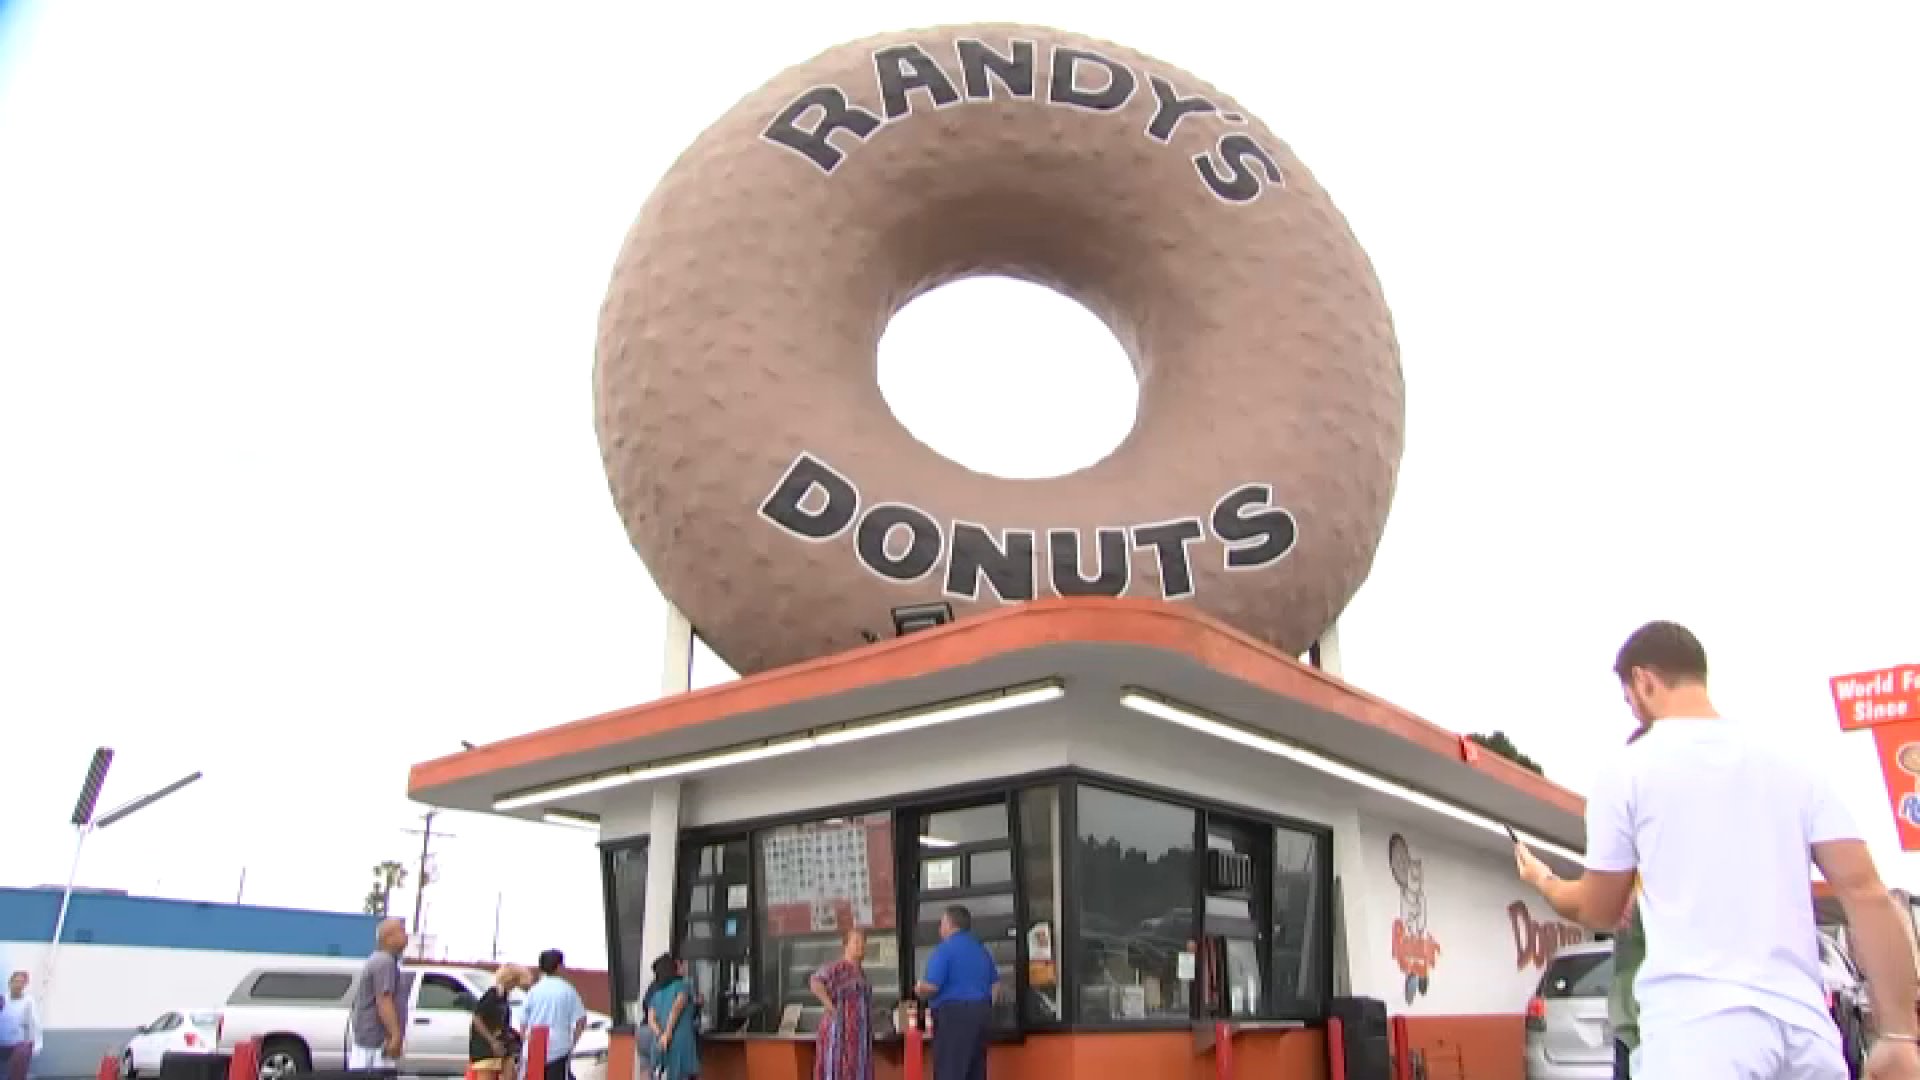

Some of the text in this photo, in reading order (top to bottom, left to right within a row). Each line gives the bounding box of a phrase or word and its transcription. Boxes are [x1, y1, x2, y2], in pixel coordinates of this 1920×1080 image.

[760, 38, 1285, 205] RANDY'S
[757, 451, 1297, 602] DONUTS
[1837, 672, 1894, 700] World
[1853, 700, 1907, 721] Since
